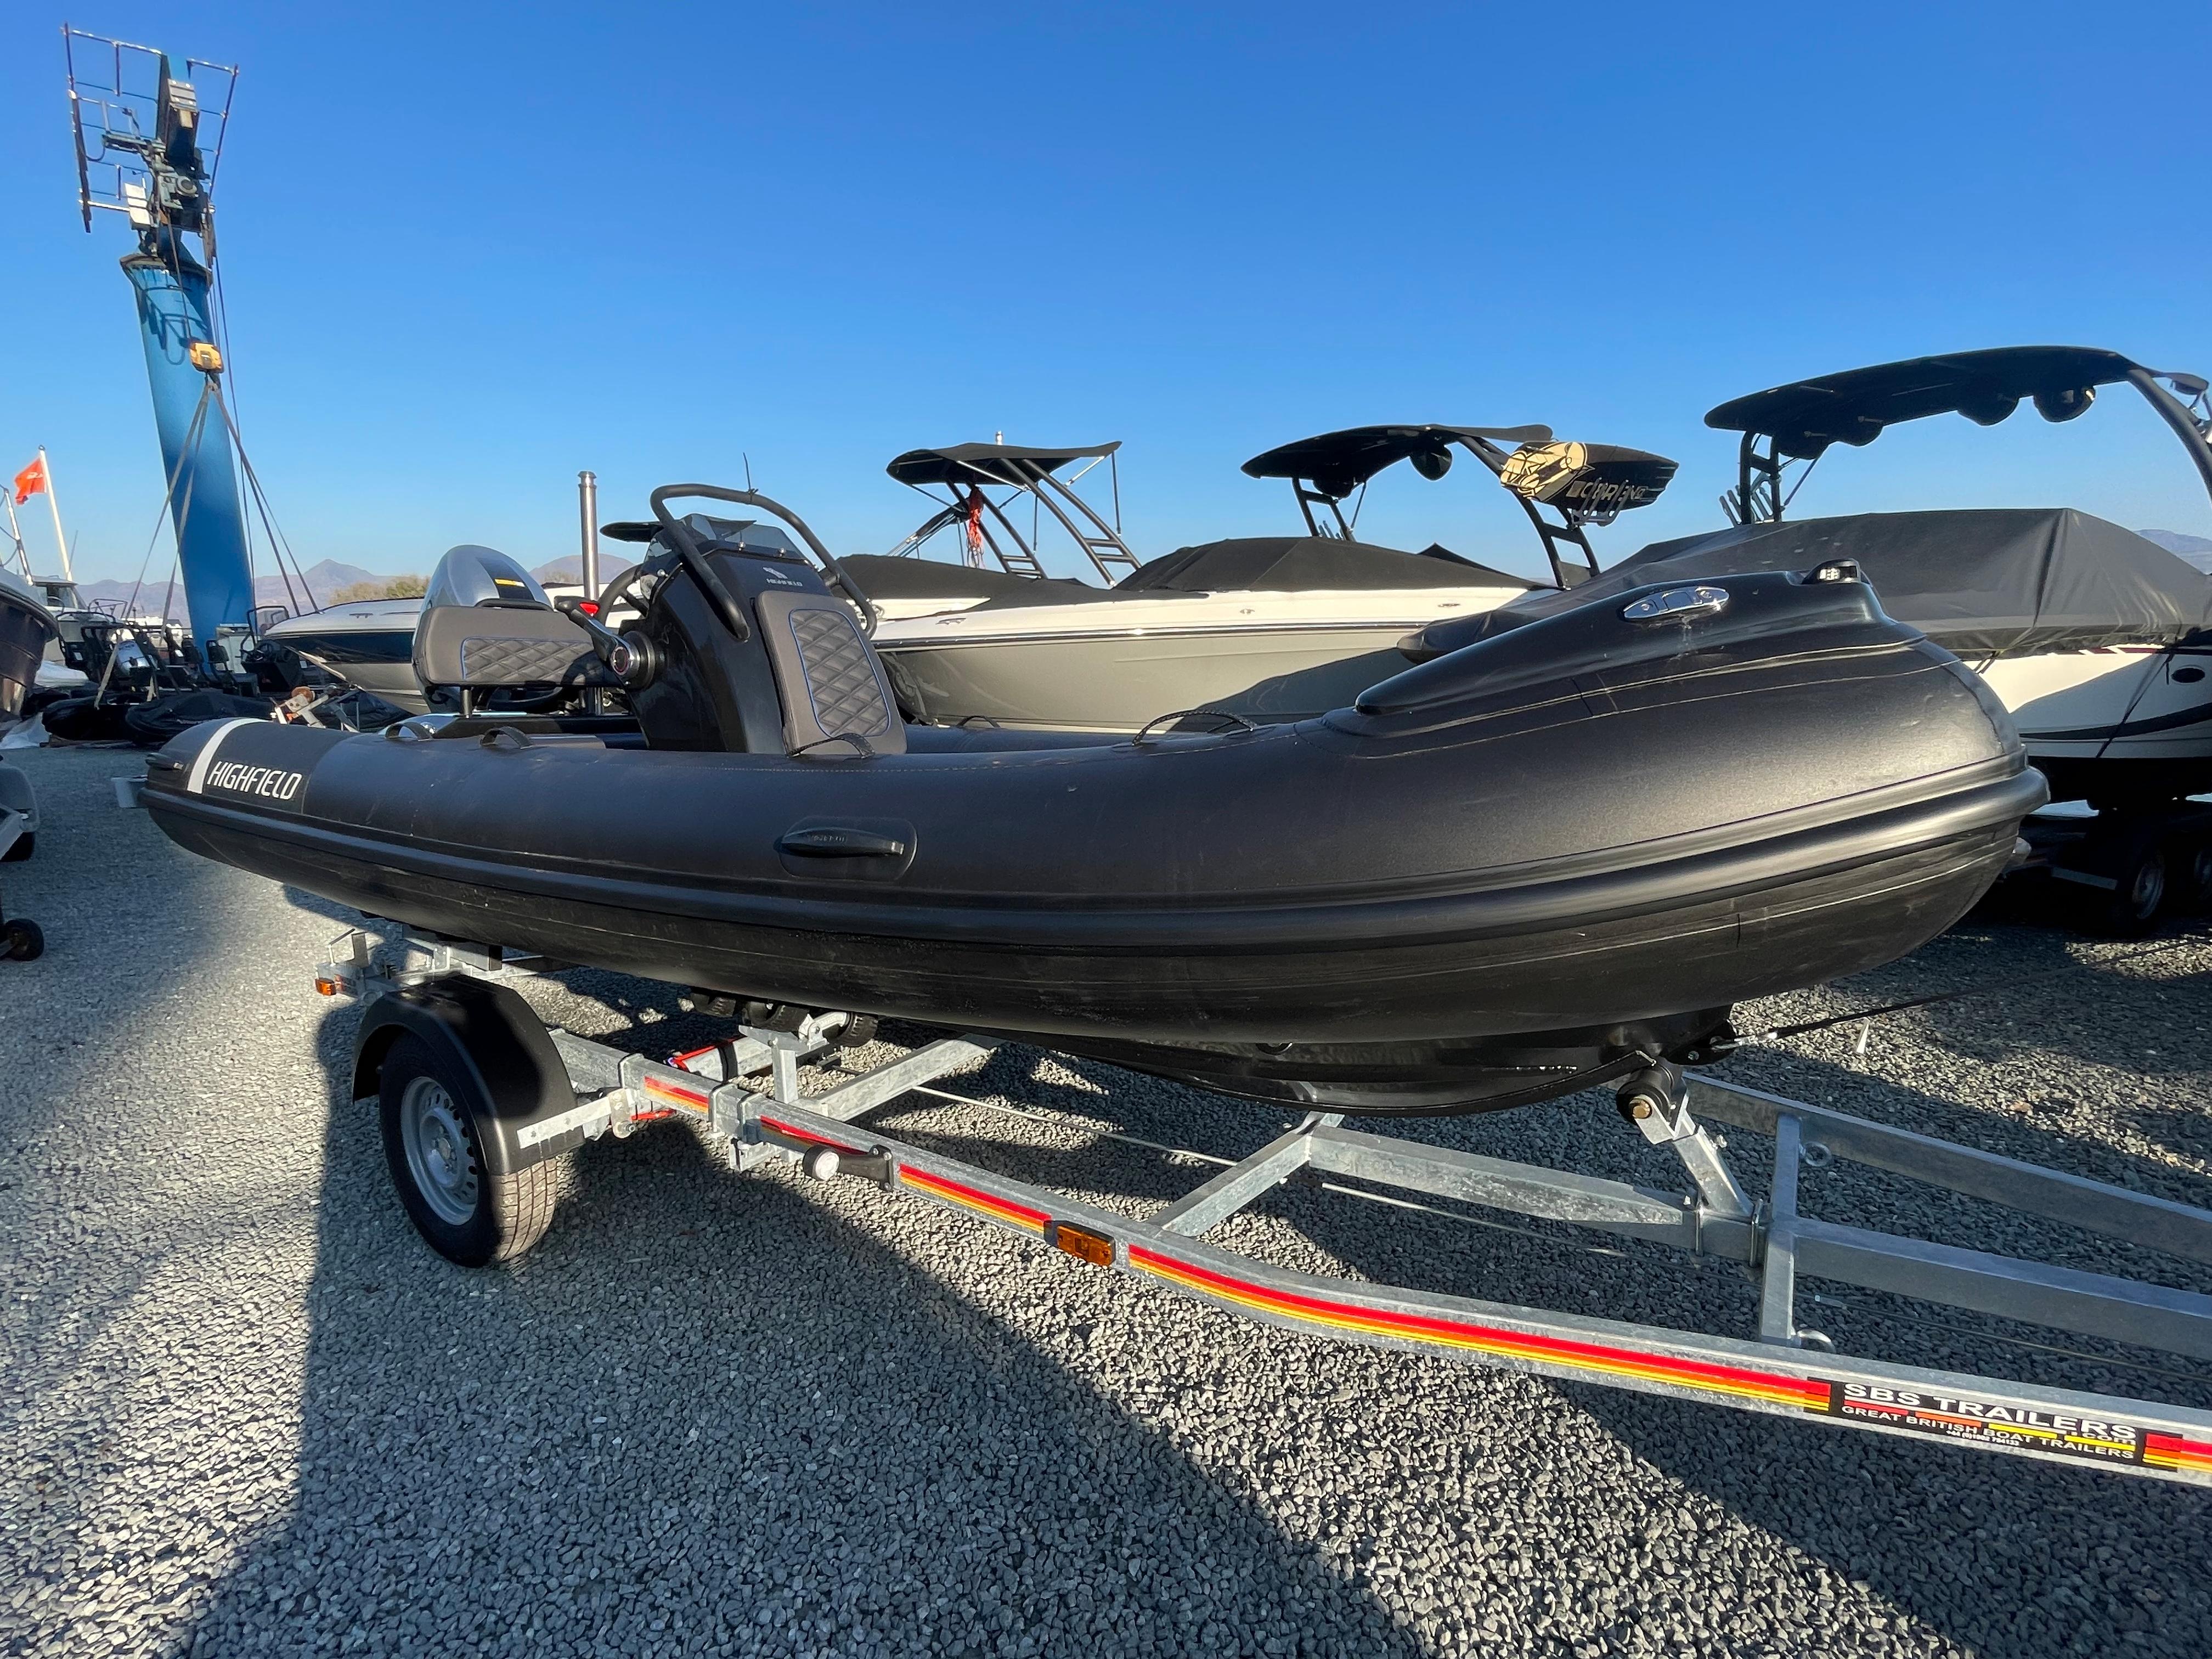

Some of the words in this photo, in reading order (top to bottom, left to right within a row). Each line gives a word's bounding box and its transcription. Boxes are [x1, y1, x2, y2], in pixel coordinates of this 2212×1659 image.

[206, 760, 303, 800] HIGHFIELD
[1841, 1406, 1901, 1422] GREAT
[1906, 1416, 1978, 1434] BRITISH
[1983, 1427, 2034, 1443] BOAT
[2039, 1437, 2134, 1459] TRAILERS
[1844, 1383, 1920, 1406] SBS
[1932, 1396, 2137, 1439] TRAILERS
[2070, 1430, 2136, 1445] .com
